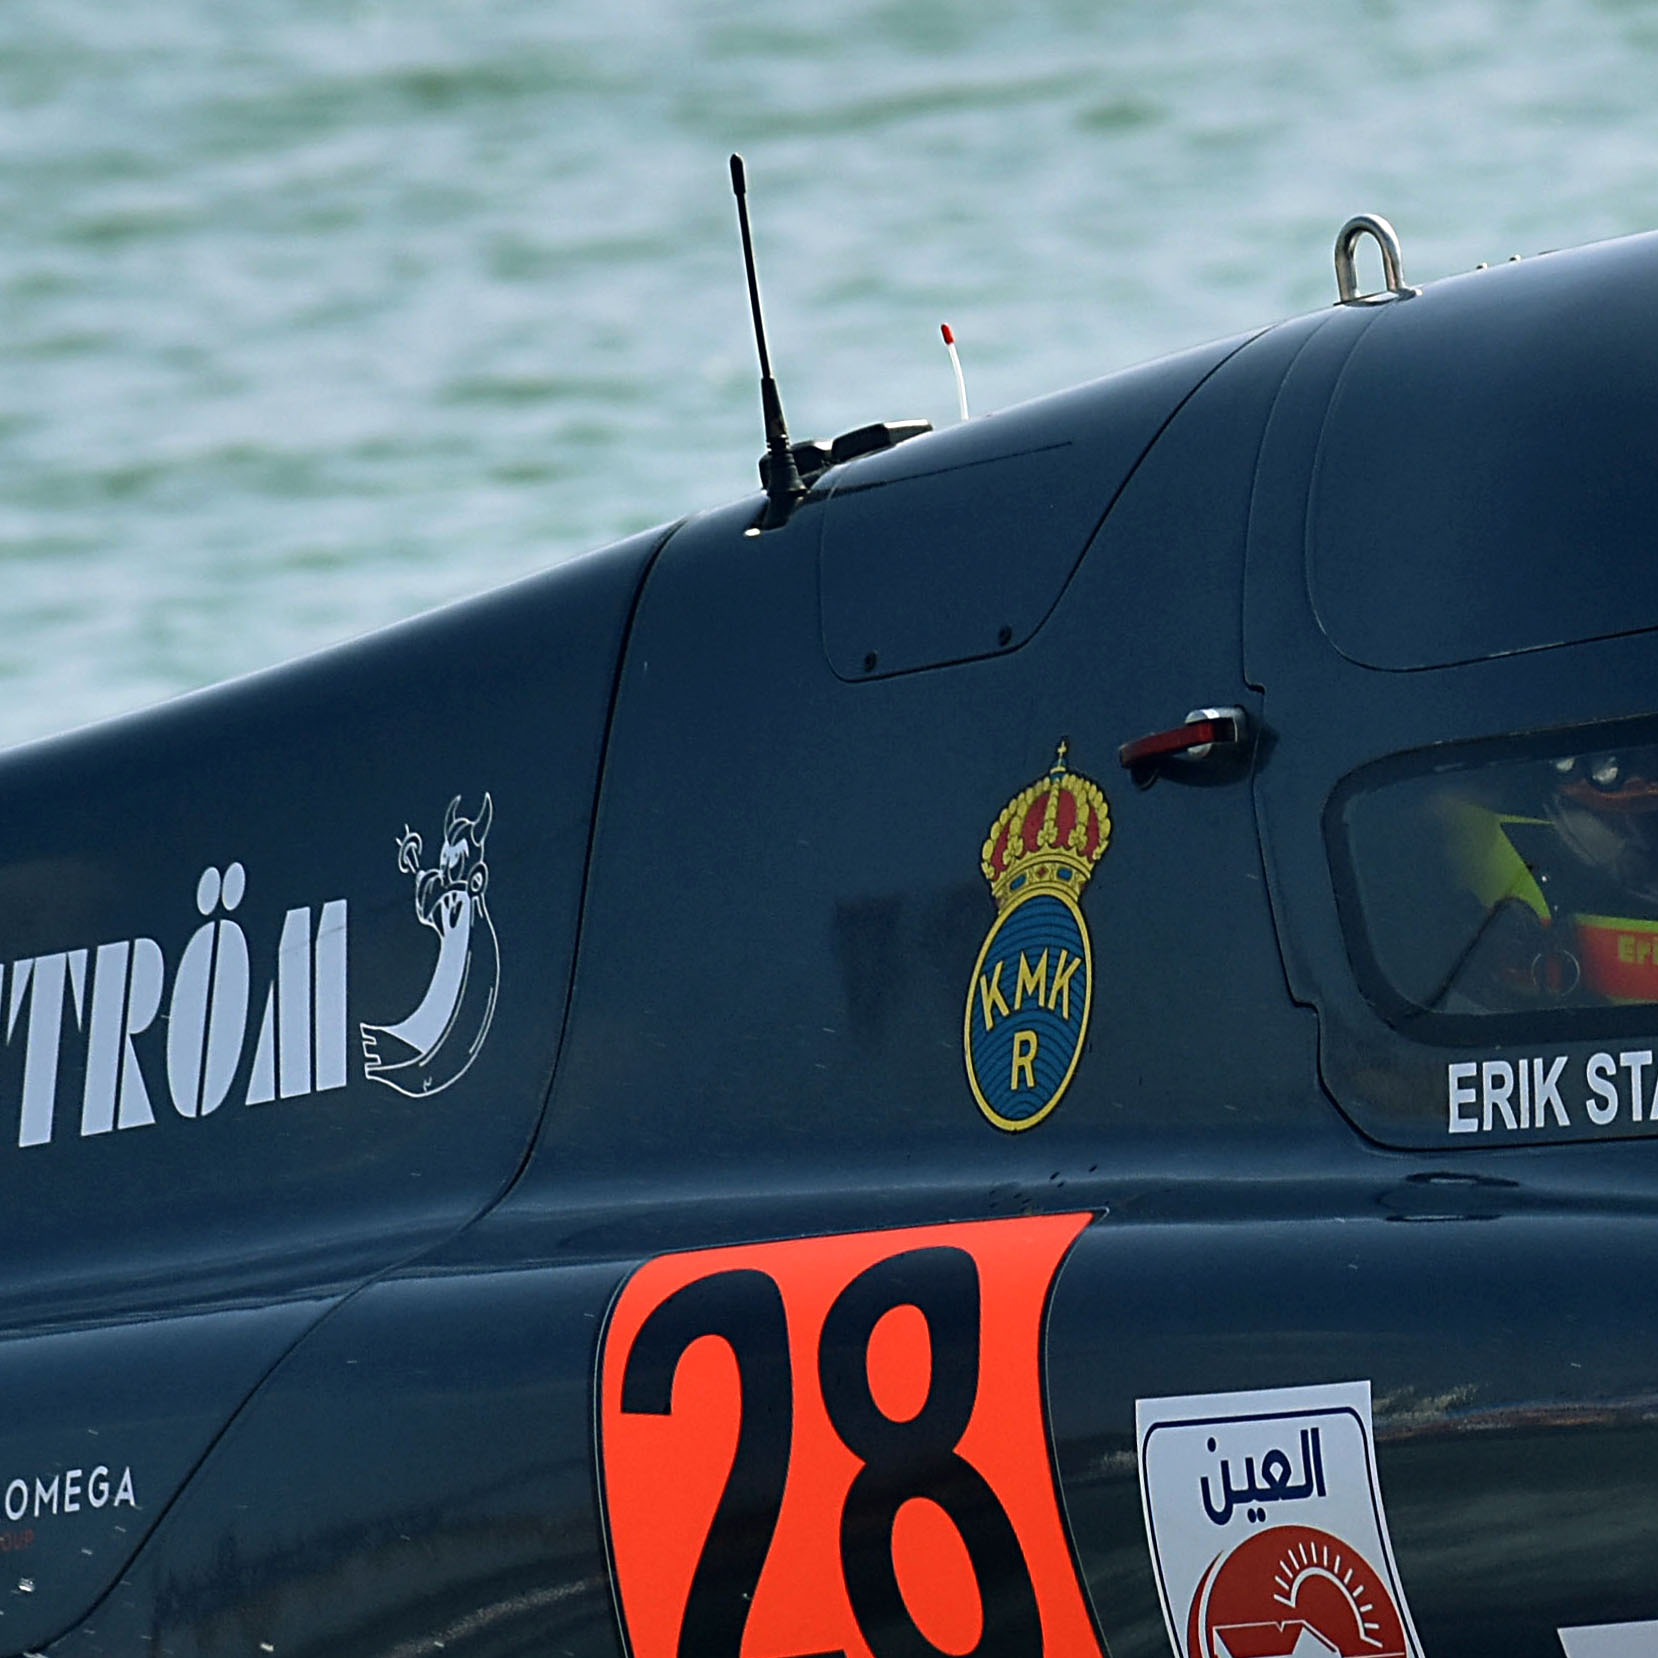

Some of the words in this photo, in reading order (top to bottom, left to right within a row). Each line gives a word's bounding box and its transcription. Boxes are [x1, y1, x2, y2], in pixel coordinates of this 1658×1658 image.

[0, 862, 348, 1147] TRÖM
[980, 947, 1081, 1031] KMK
[1010, 1030, 1038, 1090] R
[1448, 1055, 1572, 1134] ERIK
[5, 1465, 136, 1520] OMEGA
[1200, 1427, 1327, 1526] العين
